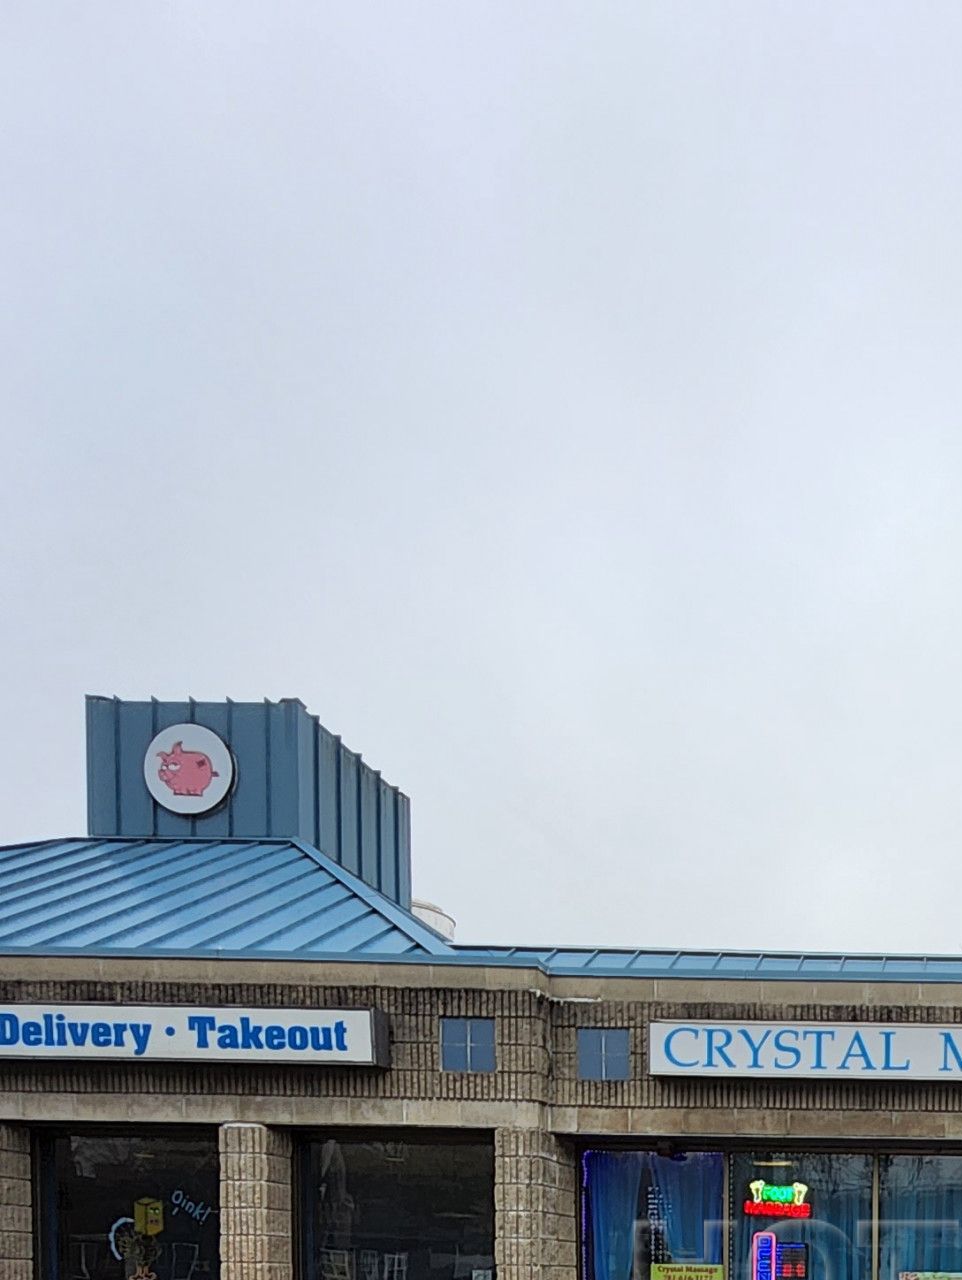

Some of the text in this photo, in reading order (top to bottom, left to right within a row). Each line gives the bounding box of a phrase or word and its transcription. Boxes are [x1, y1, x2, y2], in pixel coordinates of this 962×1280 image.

[0, 1013, 348, 1056] Delivery Takeout
[664, 1027, 910, 1071] CRYSTAL
[171, 1190, 211, 1226] Oink!
